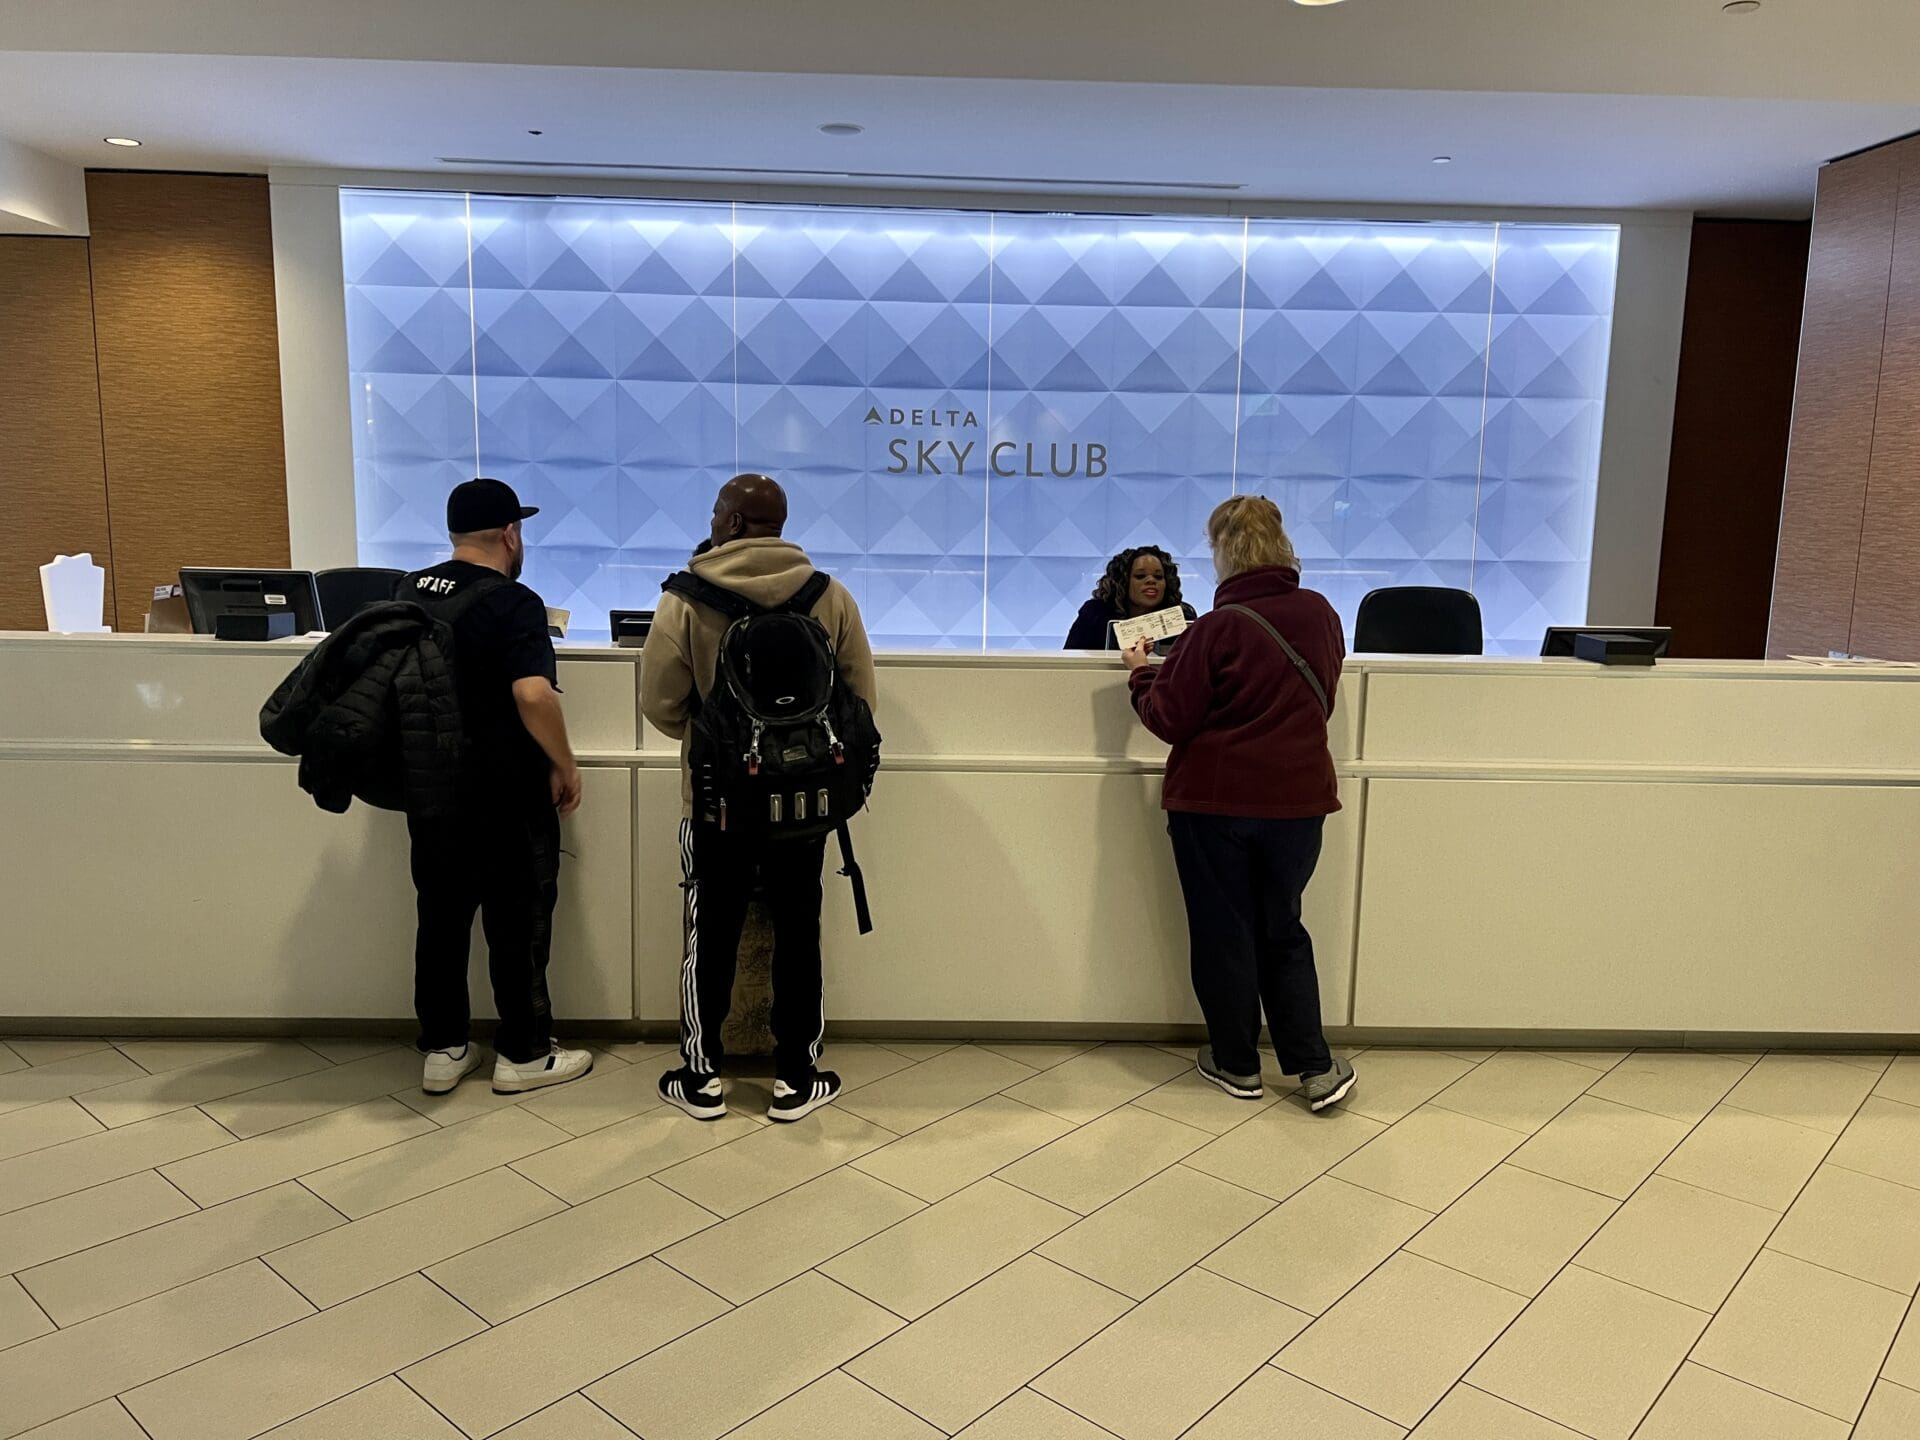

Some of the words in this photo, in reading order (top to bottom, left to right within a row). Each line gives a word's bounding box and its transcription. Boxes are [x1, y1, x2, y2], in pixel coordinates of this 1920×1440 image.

[890, 408, 978, 427] DELTA
[887, 438, 975, 476] SKY
[990, 441, 1107, 478] CLUB
[416, 576, 456, 595] STAFF
